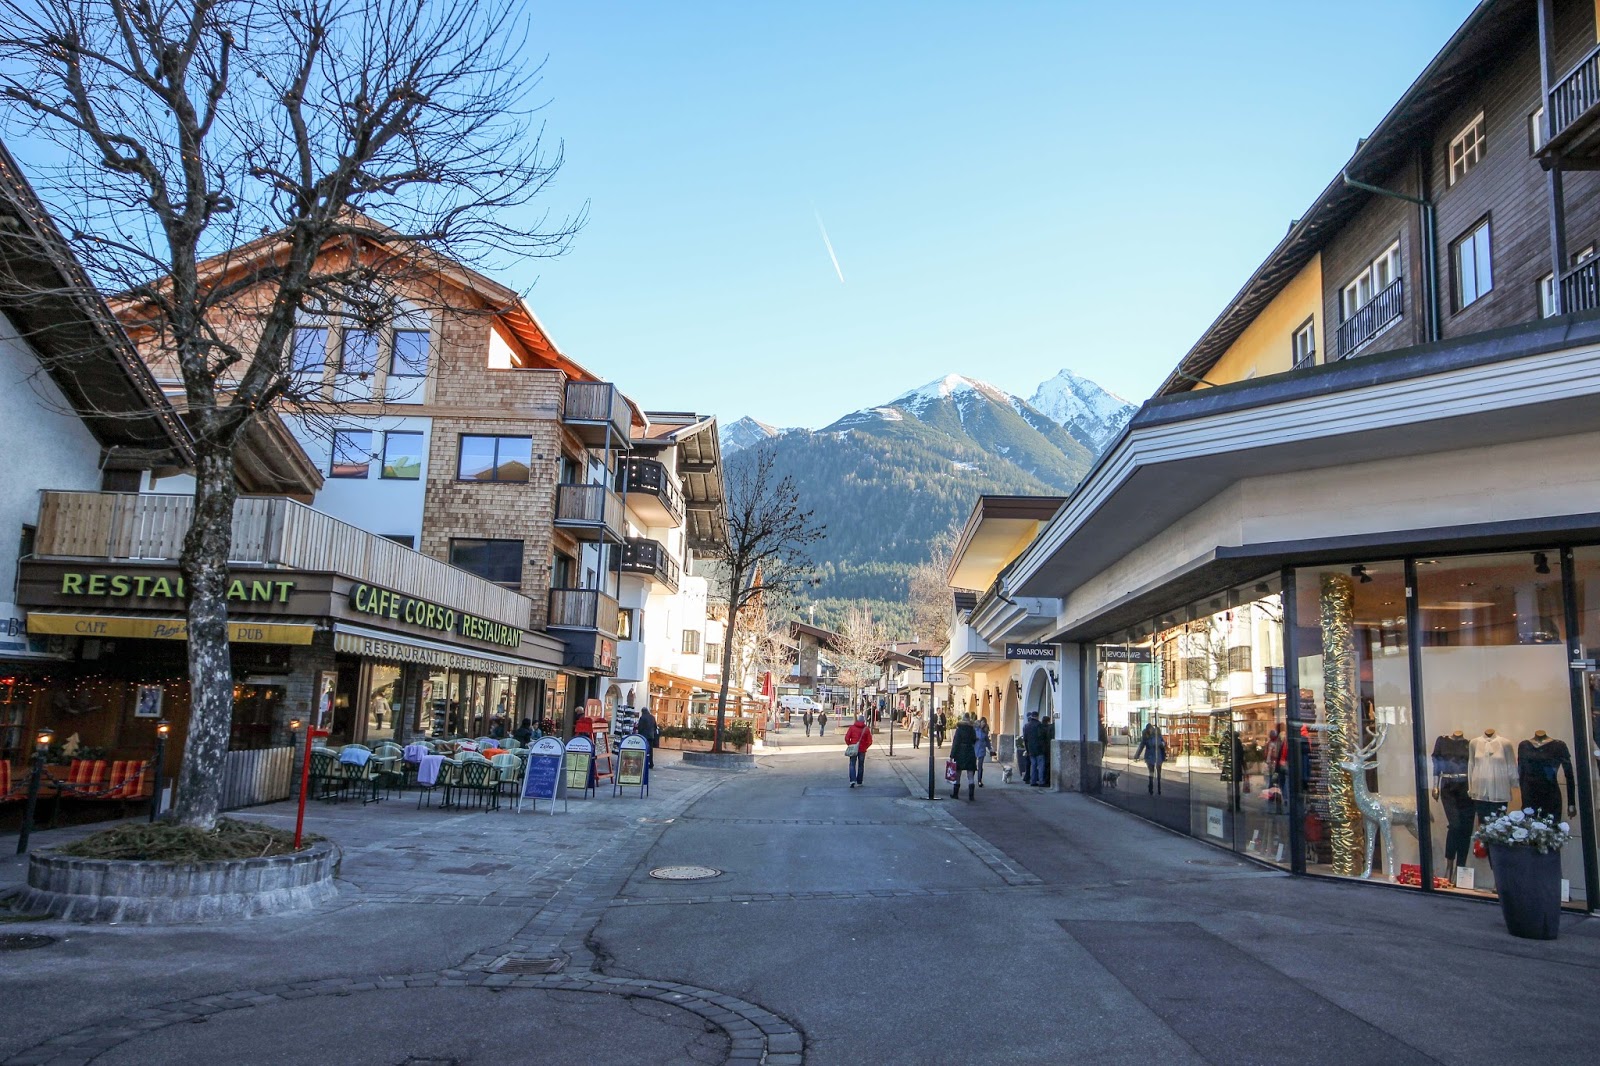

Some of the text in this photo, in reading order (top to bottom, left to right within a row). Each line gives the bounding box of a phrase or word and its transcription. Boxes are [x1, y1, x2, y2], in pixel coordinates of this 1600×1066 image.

[62, 573, 294, 602] RESTAANT
[356, 585, 524, 648] CAFE CORSO RESTAURANT
[75, 620, 107, 634] CAFE
[237, 628, 263, 641] PUB
[364, 641, 440, 663] RESTAURANT
[449, 655, 472, 668] CAFE
[480, 660, 504, 673] CORSO
[1016, 648, 1054, 656] SWAROVSKI
[519, 666, 528, 676] EIS
